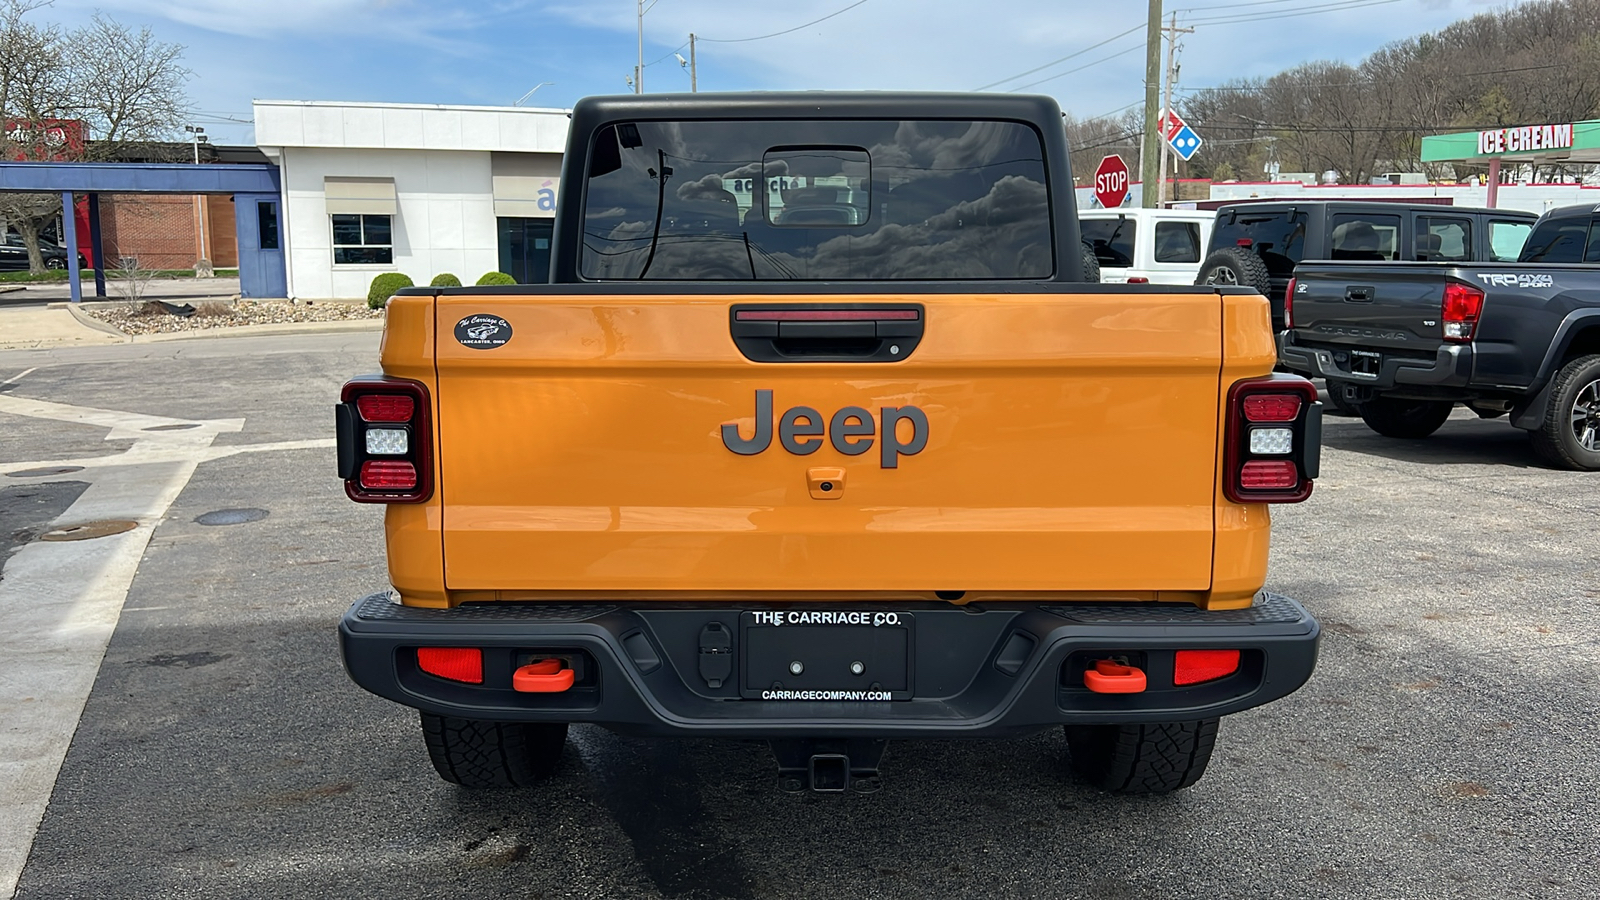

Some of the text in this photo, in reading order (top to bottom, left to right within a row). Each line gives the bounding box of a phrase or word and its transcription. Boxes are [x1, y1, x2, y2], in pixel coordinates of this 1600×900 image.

[1478, 124, 1573, 154] ICE CREAM
[1097, 170, 1127, 194] STOP
[1477, 273, 1519, 287] TRD
[1320, 326, 1407, 341] TACOMA
[720, 389, 930, 469] Jeep
[752, 611, 902, 626] THE CARRIAGE CO.
[761, 690, 892, 701] CARRIAGECOMPANY.COM
